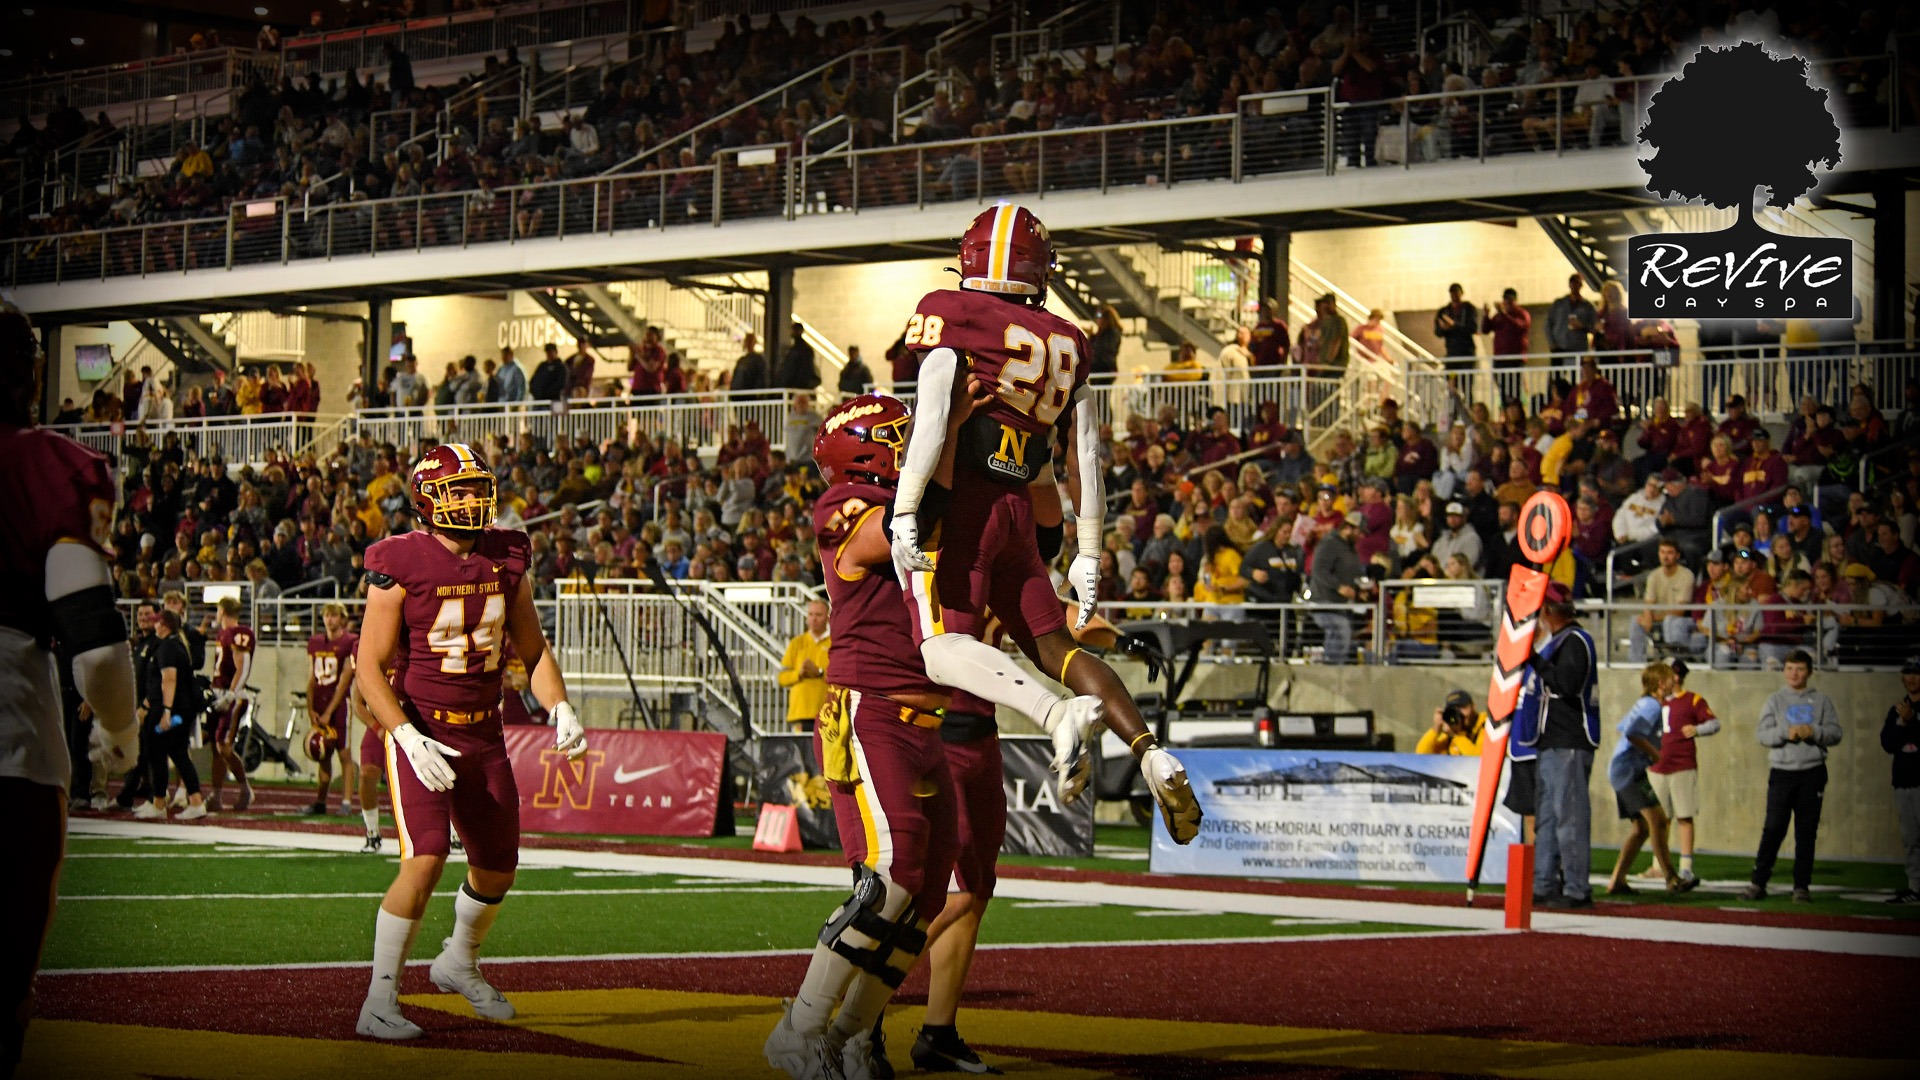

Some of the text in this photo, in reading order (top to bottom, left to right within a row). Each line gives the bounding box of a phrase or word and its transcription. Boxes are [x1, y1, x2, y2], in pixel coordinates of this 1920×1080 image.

[905, 314, 944, 346] 28
[996, 323, 1080, 425] 28
[826, 403, 883, 434] Wolves
[995, 424, 1031, 466] N
[992, 459, 1026, 476] BATTLE
[436, 581, 500, 597] NORTHERN STATE
[427, 595, 506, 674] 44
[533, 750, 605, 810] N
[1014, 778, 1061, 814] IA
[609, 794, 672, 808] TEAM
[756, 809, 788, 847] 10
[1201, 819, 1498, 841] RIVER'S MEMORIAL MORTUARY & CREMATY
[1199, 836, 1222, 849] 2nd
[1225, 837, 1294, 852] Generation
[1297, 839, 1337, 854] Family
[1341, 841, 1384, 855] Owned
[1388, 842, 1411, 855] and
